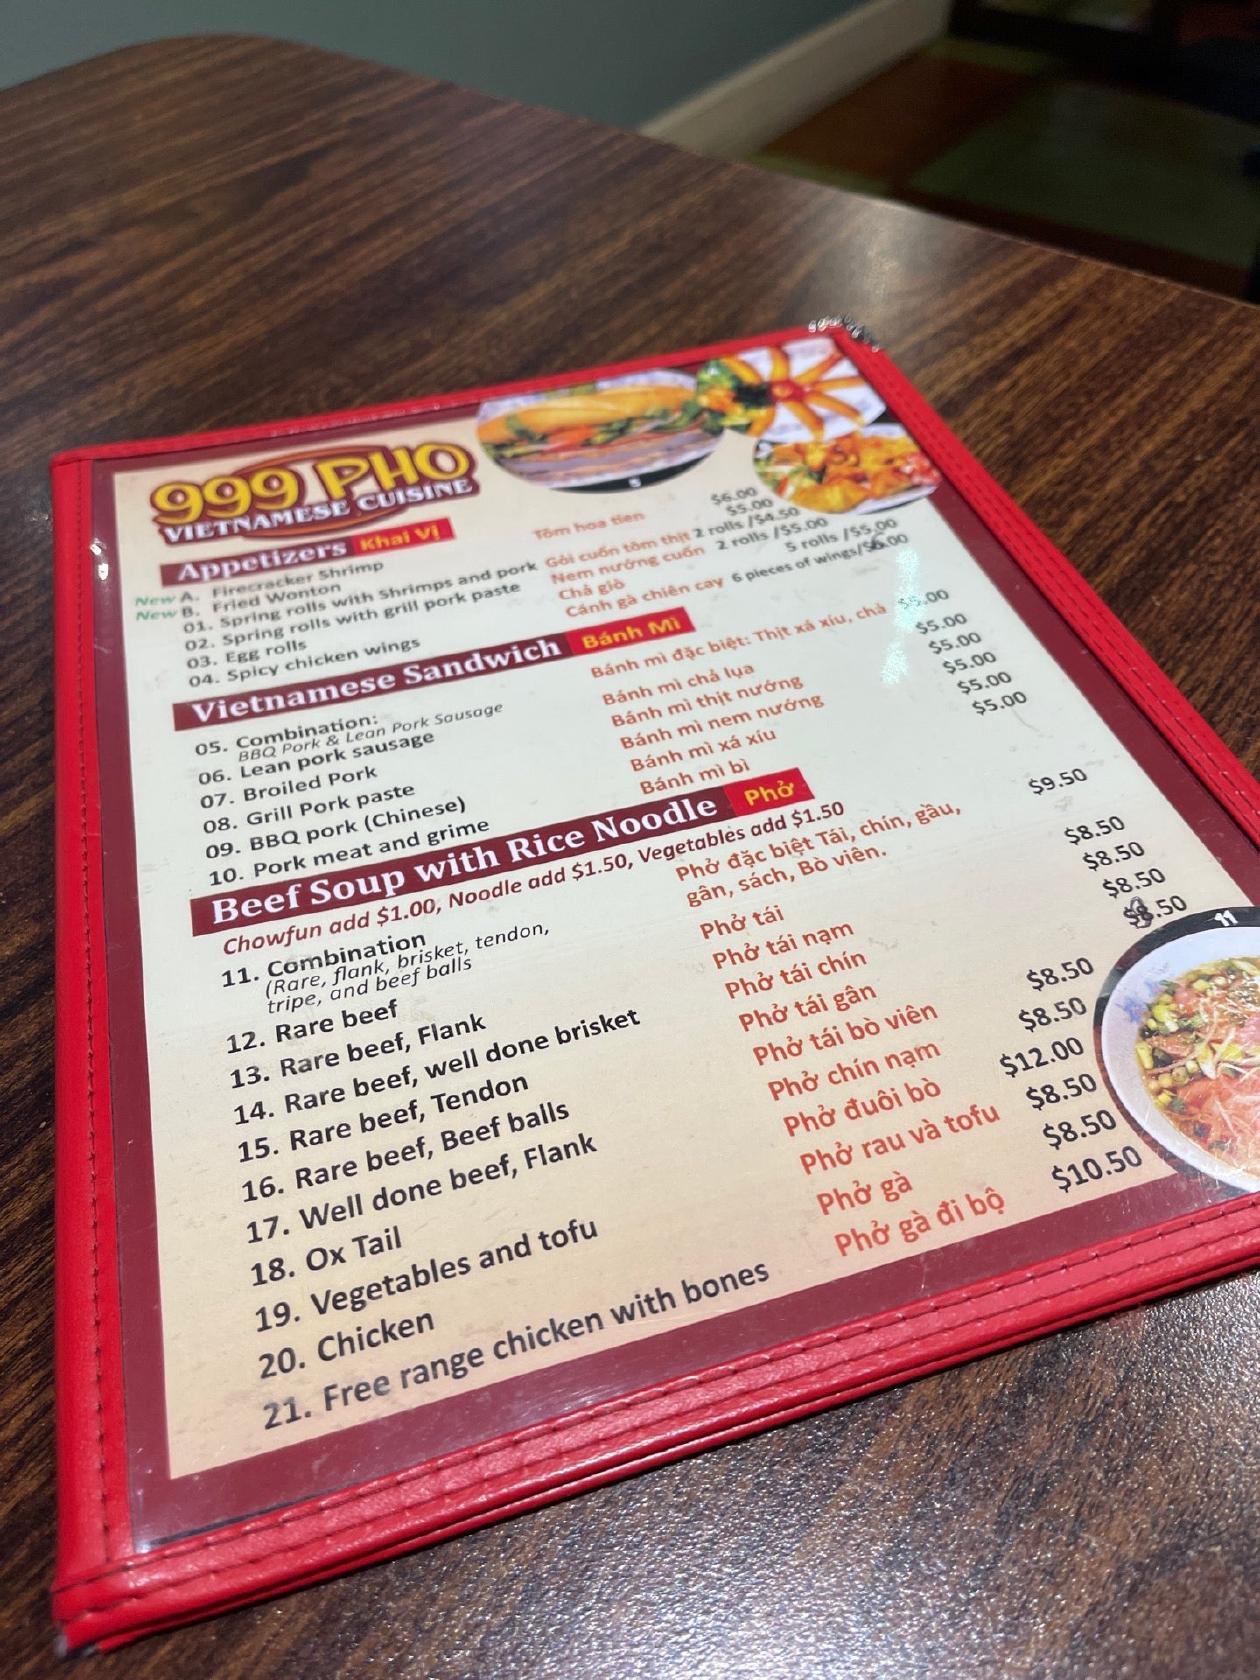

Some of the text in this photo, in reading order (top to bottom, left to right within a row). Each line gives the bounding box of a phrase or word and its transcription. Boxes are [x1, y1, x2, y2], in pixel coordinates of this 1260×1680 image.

[152, 442, 470, 525] 999 PHO
[163, 478, 474, 543] VIETNAMESE CUISINE
[179, 543, 346, 581] Appetizers
[180, 583, 342, 619] B. Fried Wonton
[182, 561, 538, 635] 01. Spring rolls with Shrimps and pork
[581, 616, 682, 650] Bánh Mì
[914, 612, 969, 636] $5.00
[186, 639, 308, 670] 03. Egg rolls
[188, 638, 421, 688] 04. Spicy chicken wings
[192, 639, 561, 722] Vietnamese Sandwich
[601, 685, 654, 706] Bánh
[656, 678, 684, 695] mì
[686, 668, 722, 688] chả
[972, 691, 1027, 716] $5.00
[194, 716, 378, 757] 05. Combination:
[237, 703, 504, 763] BBQ Pork & Lean Pork Sausage
[638, 757, 751, 796] Bánh mì bì
[744, 780, 794, 806] Phở
[1028, 768, 1087, 795] $9.50
[205, 796, 465, 860] 09. BBQ pork (Chinese)
[674, 857, 721, 882] Phở
[726, 849, 768, 870] đặc
[767, 836, 816, 859] biệt
[814, 826, 857, 846] Tái,
[859, 814, 913, 837] chín,
[1064, 816, 1125, 845] $8.50
[208, 821, 489, 887] 10. Pork meat and grime
[212, 799, 717, 924] Beef Soup with Rice Noodle
[223, 801, 844, 955] Chowfun add $1.00, Noodle add $1.50, Vegetables add $1.50
[700, 904, 785, 939] Phở tái
[1214, 909, 1239, 928] 11
[221, 935, 426, 988] 11. Combination
[332, 959, 389, 986] flank,
[398, 941, 468, 969] brisket,
[475, 924, 549, 949] tendon,
[725, 951, 867, 999] Phở tái chín
[1026, 957, 1094, 992] $8.50
[267, 955, 473, 1015] tripe, and beef balls
[226, 998, 397, 1055] 12. Rare beef
[1018, 997, 1087, 1033] $8.50
[999, 1037, 1084, 1078] $12.00
[783, 1077, 941, 1137] Phở đuôi bò
[1043, 1110, 1116, 1150] $8.50
[800, 1104, 1000, 1175] Phở rau và tofu
[816, 1171, 913, 1215] Phở gà
[1051, 1146, 1142, 1193] $10.50
[835, 1187, 1004, 1257] Phở gà đi bộ
[251, 1225, 402, 1286] 18. Ox Tail
[256, 1219, 598, 1332] 19. Vegetables and tofu
[259, 1313, 434, 1379] 20. Chicken
[263, 1264, 769, 1430] 21. Free range chicken with bones
